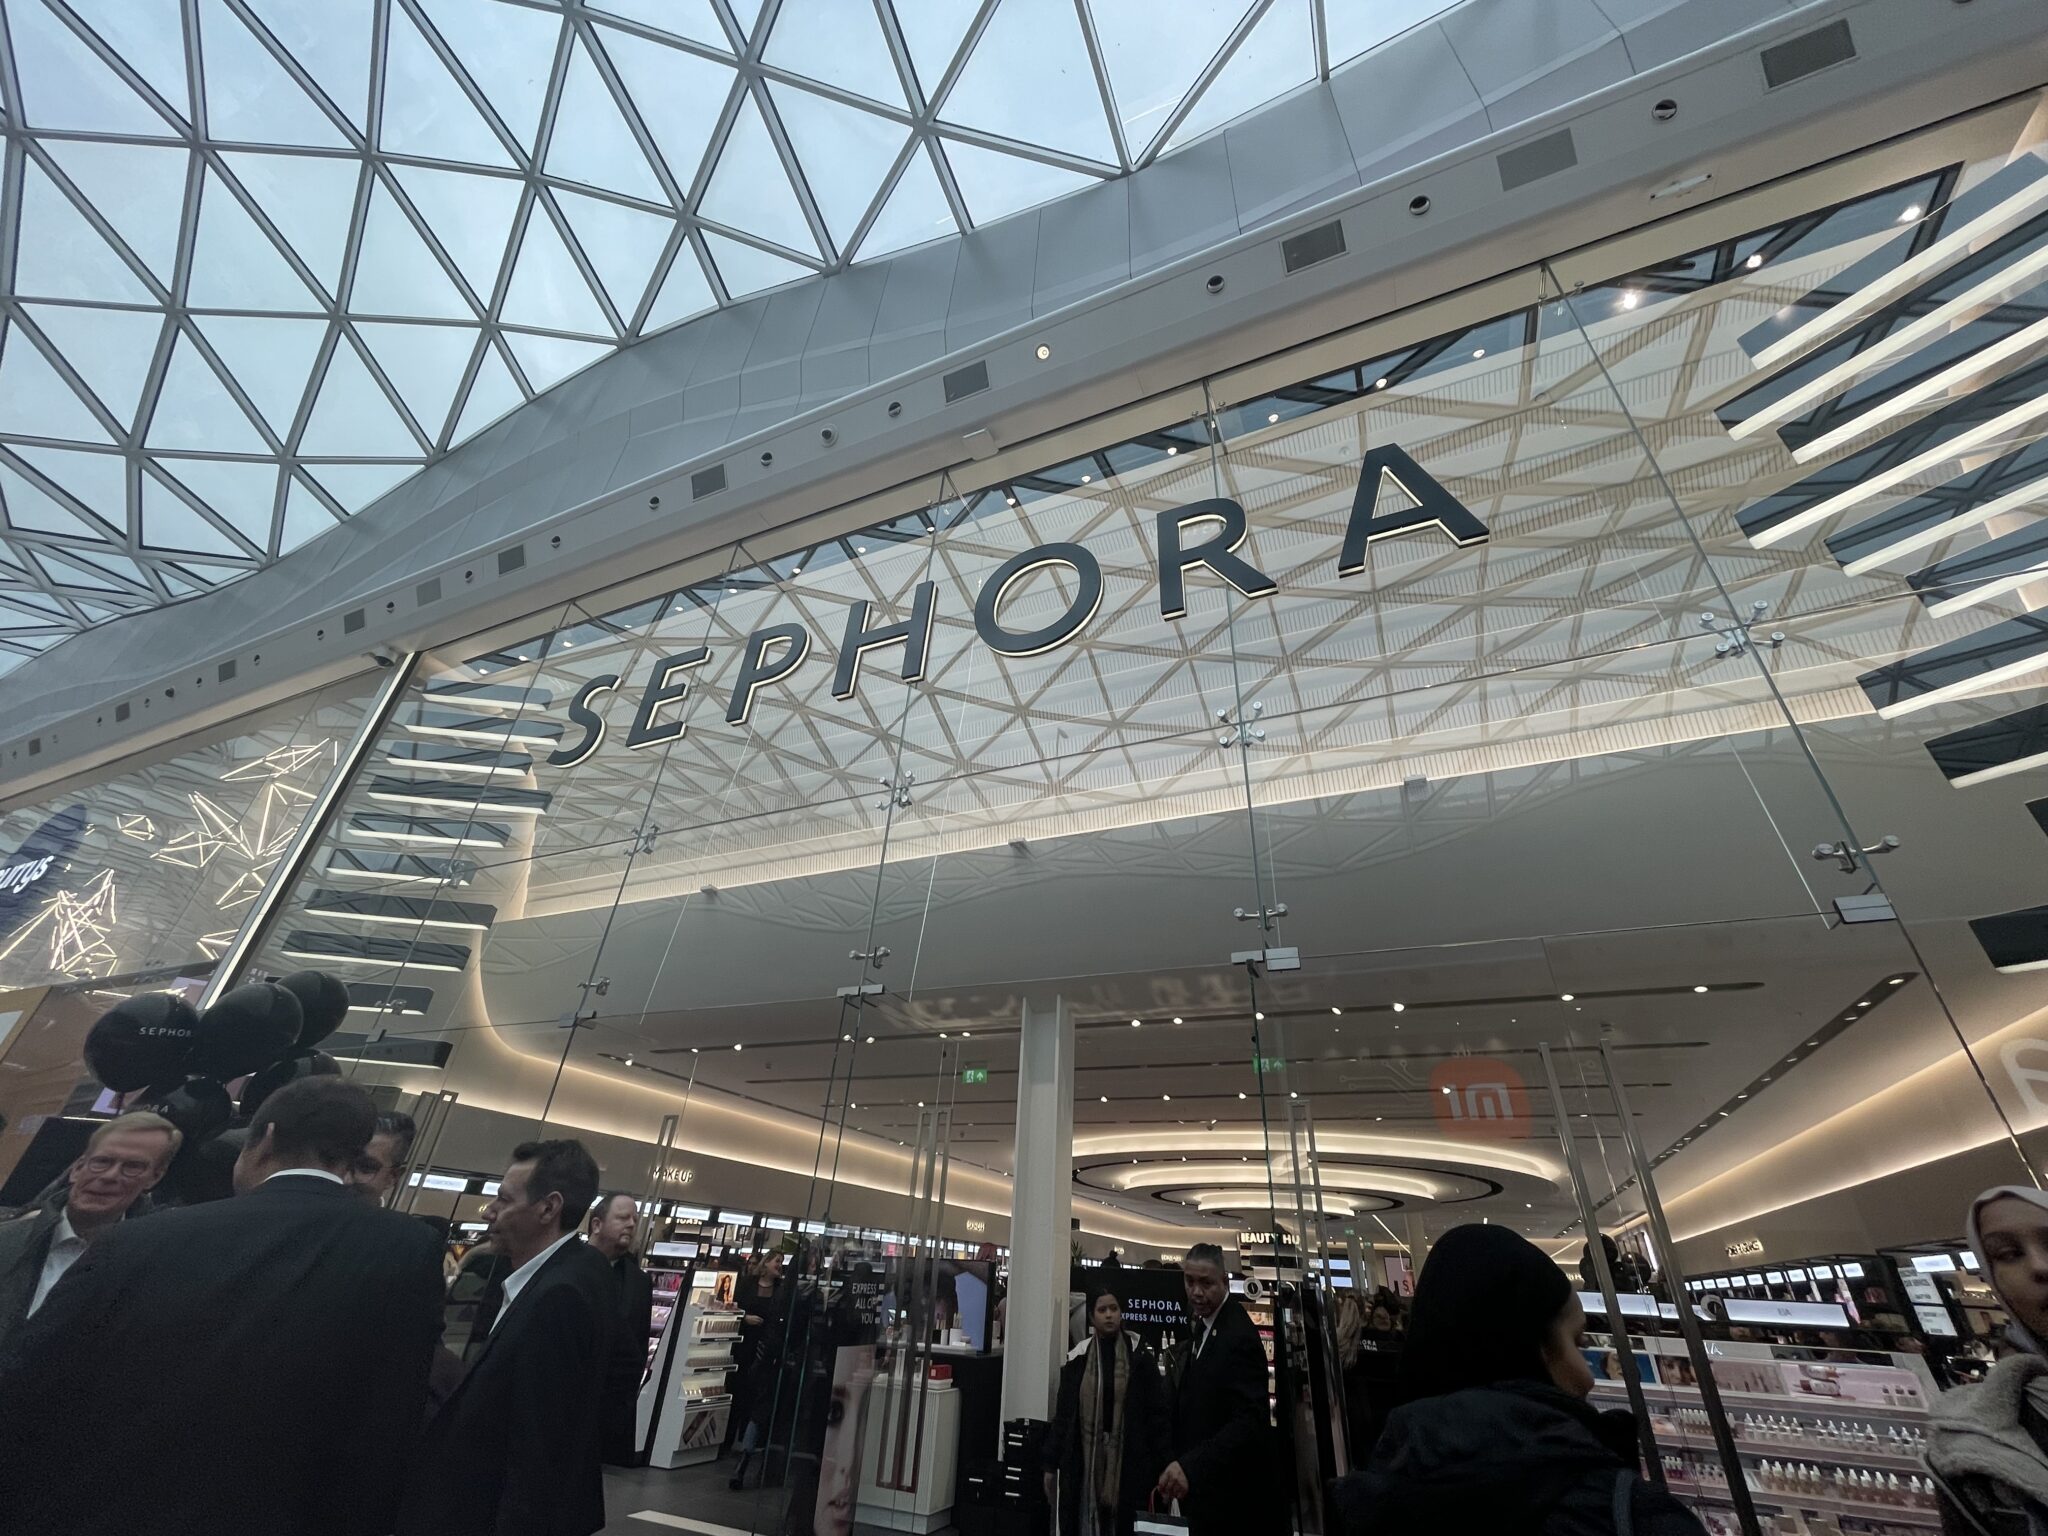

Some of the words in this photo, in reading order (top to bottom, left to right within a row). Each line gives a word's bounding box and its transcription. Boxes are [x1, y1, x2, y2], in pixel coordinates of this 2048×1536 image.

[546, 443, 1489, 769] SEPHORA
[0, 855, 54, 893] urrys
[139, 1027, 192, 1037] SEPHOR
[1282, 1234, 1300, 1245] HU
[852, 1283, 877, 1294] EXPRESS
[1128, 1299, 1181, 1311] SEPHORA
[1121, 1312, 1147, 1322] XPRESS
[1150, 1314, 1163, 1323] ALL
[1165, 1315, 1177, 1324] OF
